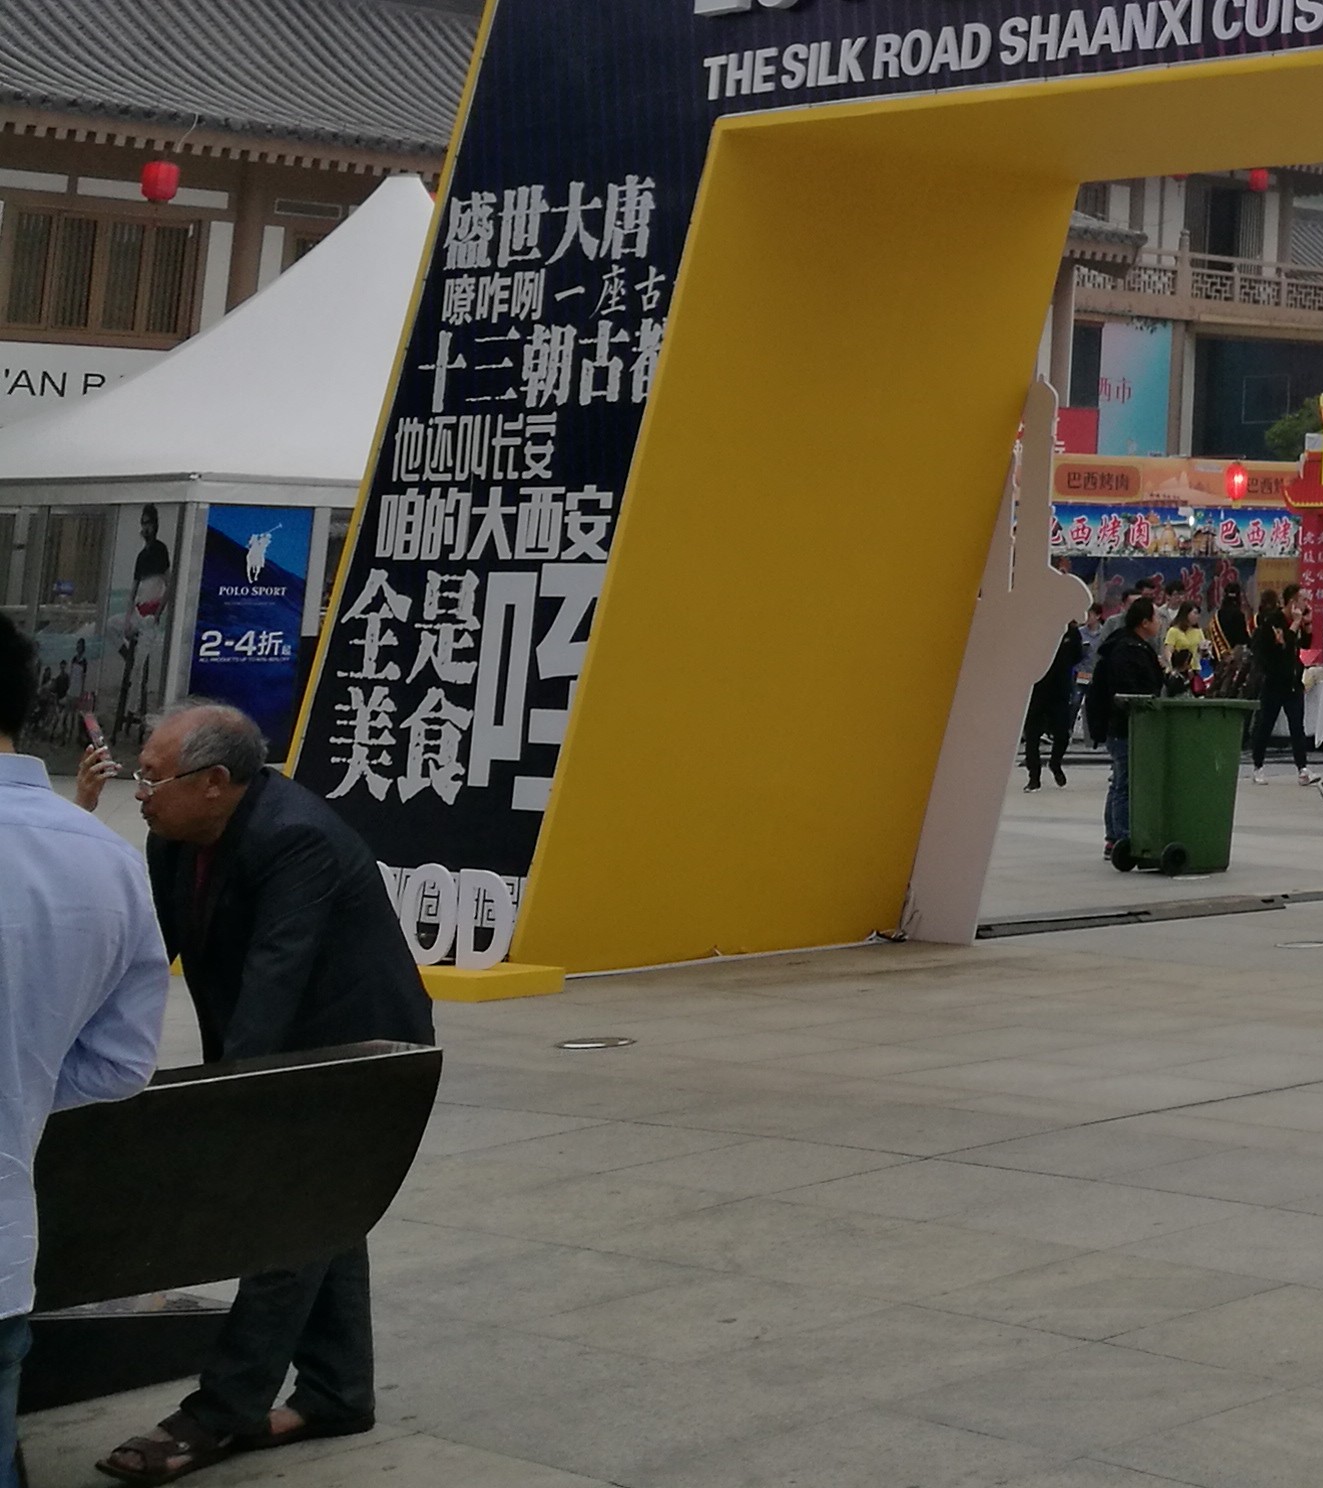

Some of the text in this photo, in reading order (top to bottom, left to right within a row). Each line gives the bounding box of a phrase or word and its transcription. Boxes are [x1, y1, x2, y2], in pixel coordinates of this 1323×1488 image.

[703, 47, 779, 101] THE
[781, 36, 865, 91] SILK
[872, 22, 993, 80] ROAD
[442, 174, 656, 271] 盛世大唐
[1066, 470, 1130, 492] 巴西烤肉
[1220, 517, 1302, 550] 巴西烤
[219, 585, 288, 597] POLO SPORT
[336, 569, 481, 686] 全是
[325, 685, 475, 806] 美食
[377, 860, 519, 970] OD
